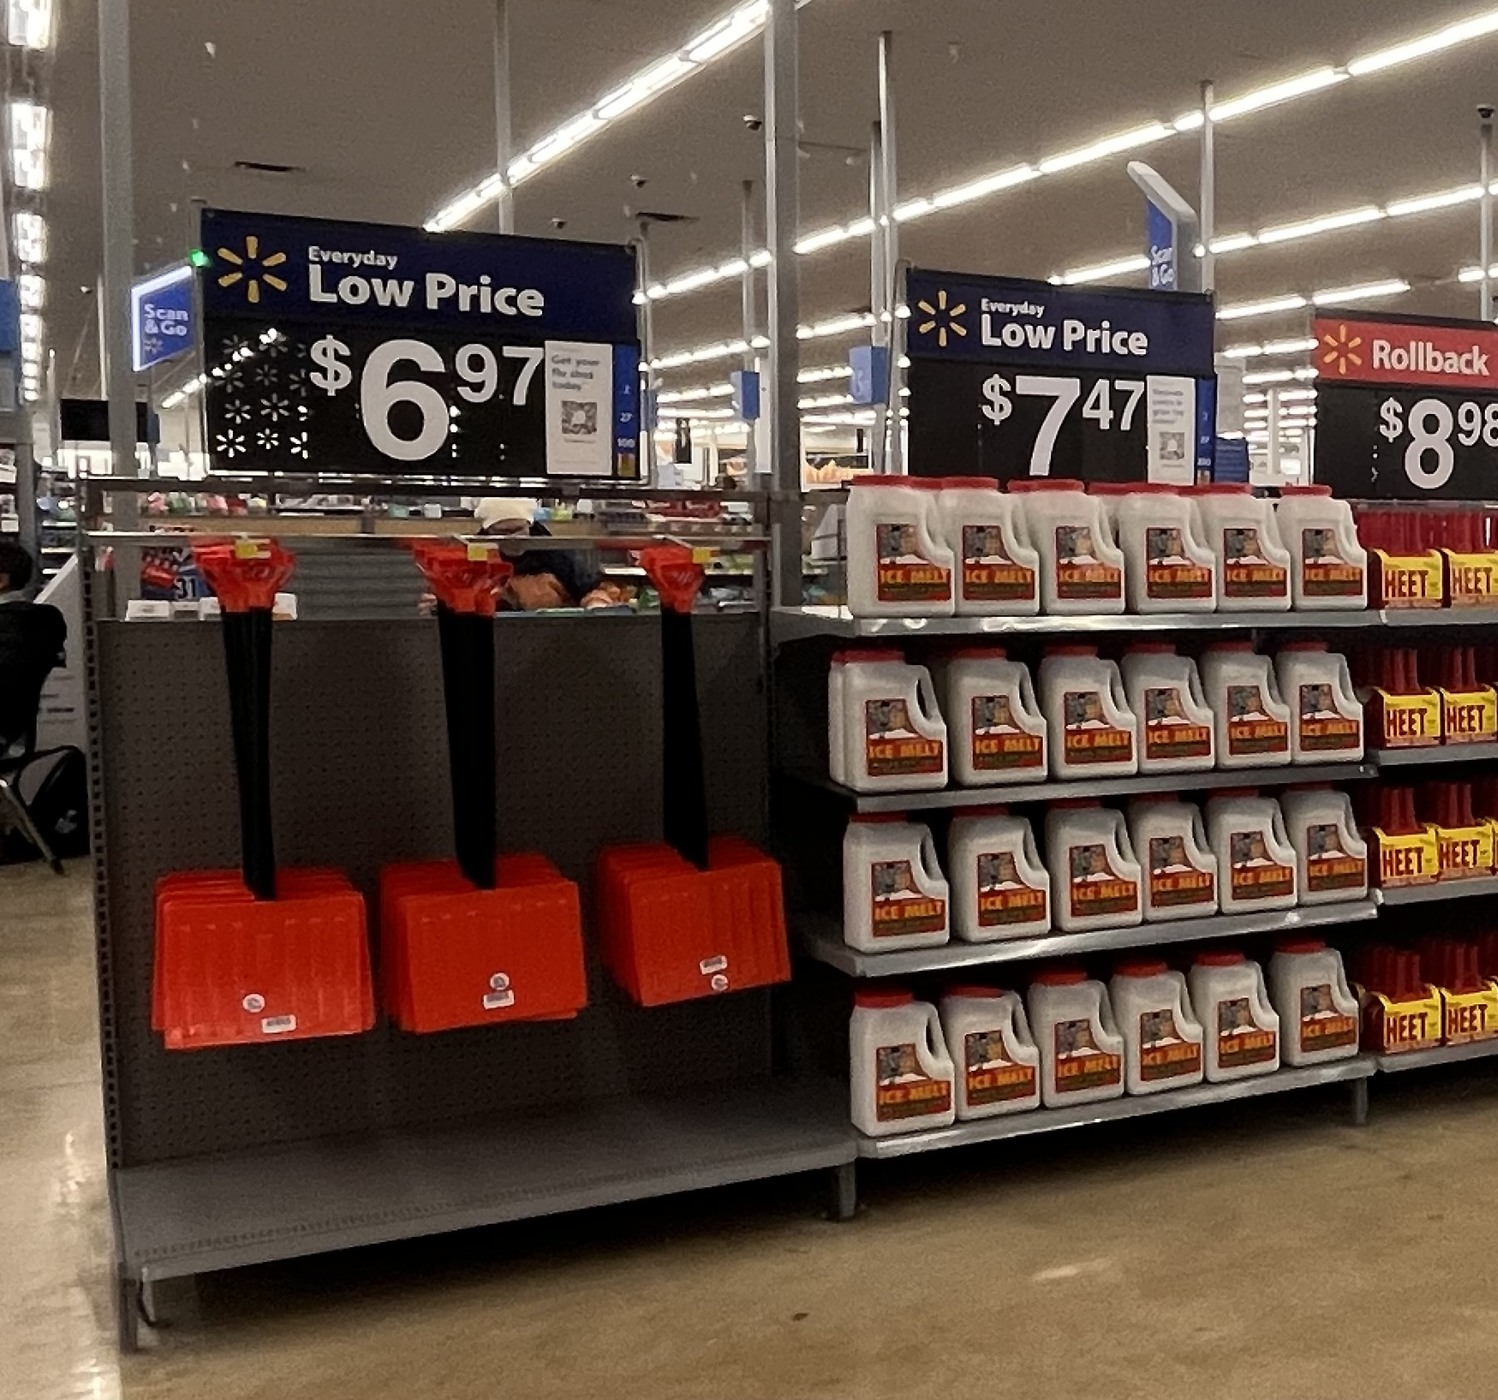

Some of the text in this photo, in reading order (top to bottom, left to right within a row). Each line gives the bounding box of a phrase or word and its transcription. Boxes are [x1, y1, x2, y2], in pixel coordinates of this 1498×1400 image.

[308, 245, 398, 270] Everyday
[308, 263, 545, 316] Low Price
[144, 303, 189, 321] Scan
[981, 297, 1045, 318] Everyday
[981, 313, 1148, 355] Low Price
[1373, 339, 1490, 376] Rollback
[881, 570, 902, 583] ICE
[965, 570, 988, 582] ICE
[1384, 569, 1428, 598] HEET
[1452, 567, 1492, 594] HEET
[1386, 708, 1427, 736] HEET
[1445, 705, 1486, 733] HEET
[870, 745, 893, 758] ICE
[976, 742, 998, 754] ICE
[1066, 736, 1089, 748] ICE
[1383, 847, 1424, 876] HEET
[1438, 840, 1481, 868] HEET
[981, 898, 1000, 911] ICE
[1074, 887, 1095, 900] ICE
[875, 906, 896, 919] ICE
[1386, 1012, 1428, 1042] HEET
[1446, 1004, 1488, 1033] HEET
